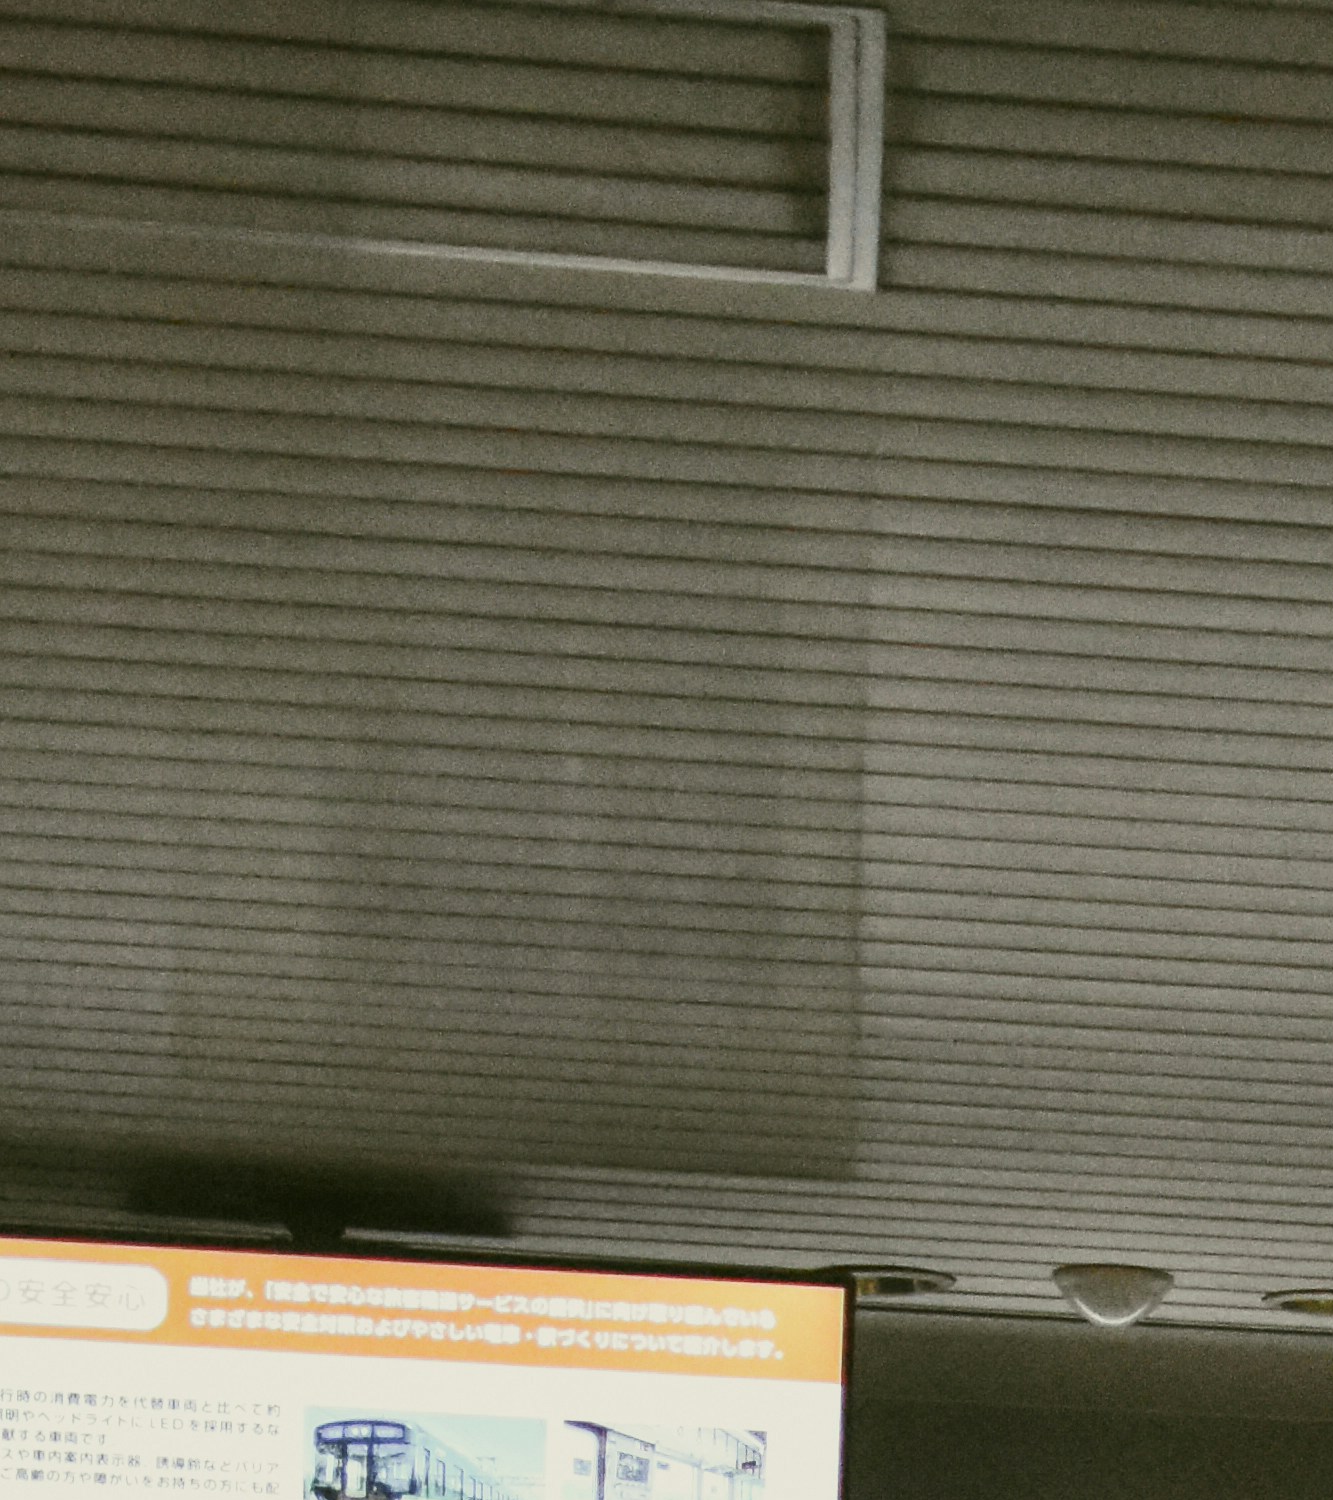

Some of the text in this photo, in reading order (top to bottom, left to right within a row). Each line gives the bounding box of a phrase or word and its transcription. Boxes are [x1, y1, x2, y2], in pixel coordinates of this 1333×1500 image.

[0, 1408, 280, 1436] 明やヘッドライトにLEDを採用するな
